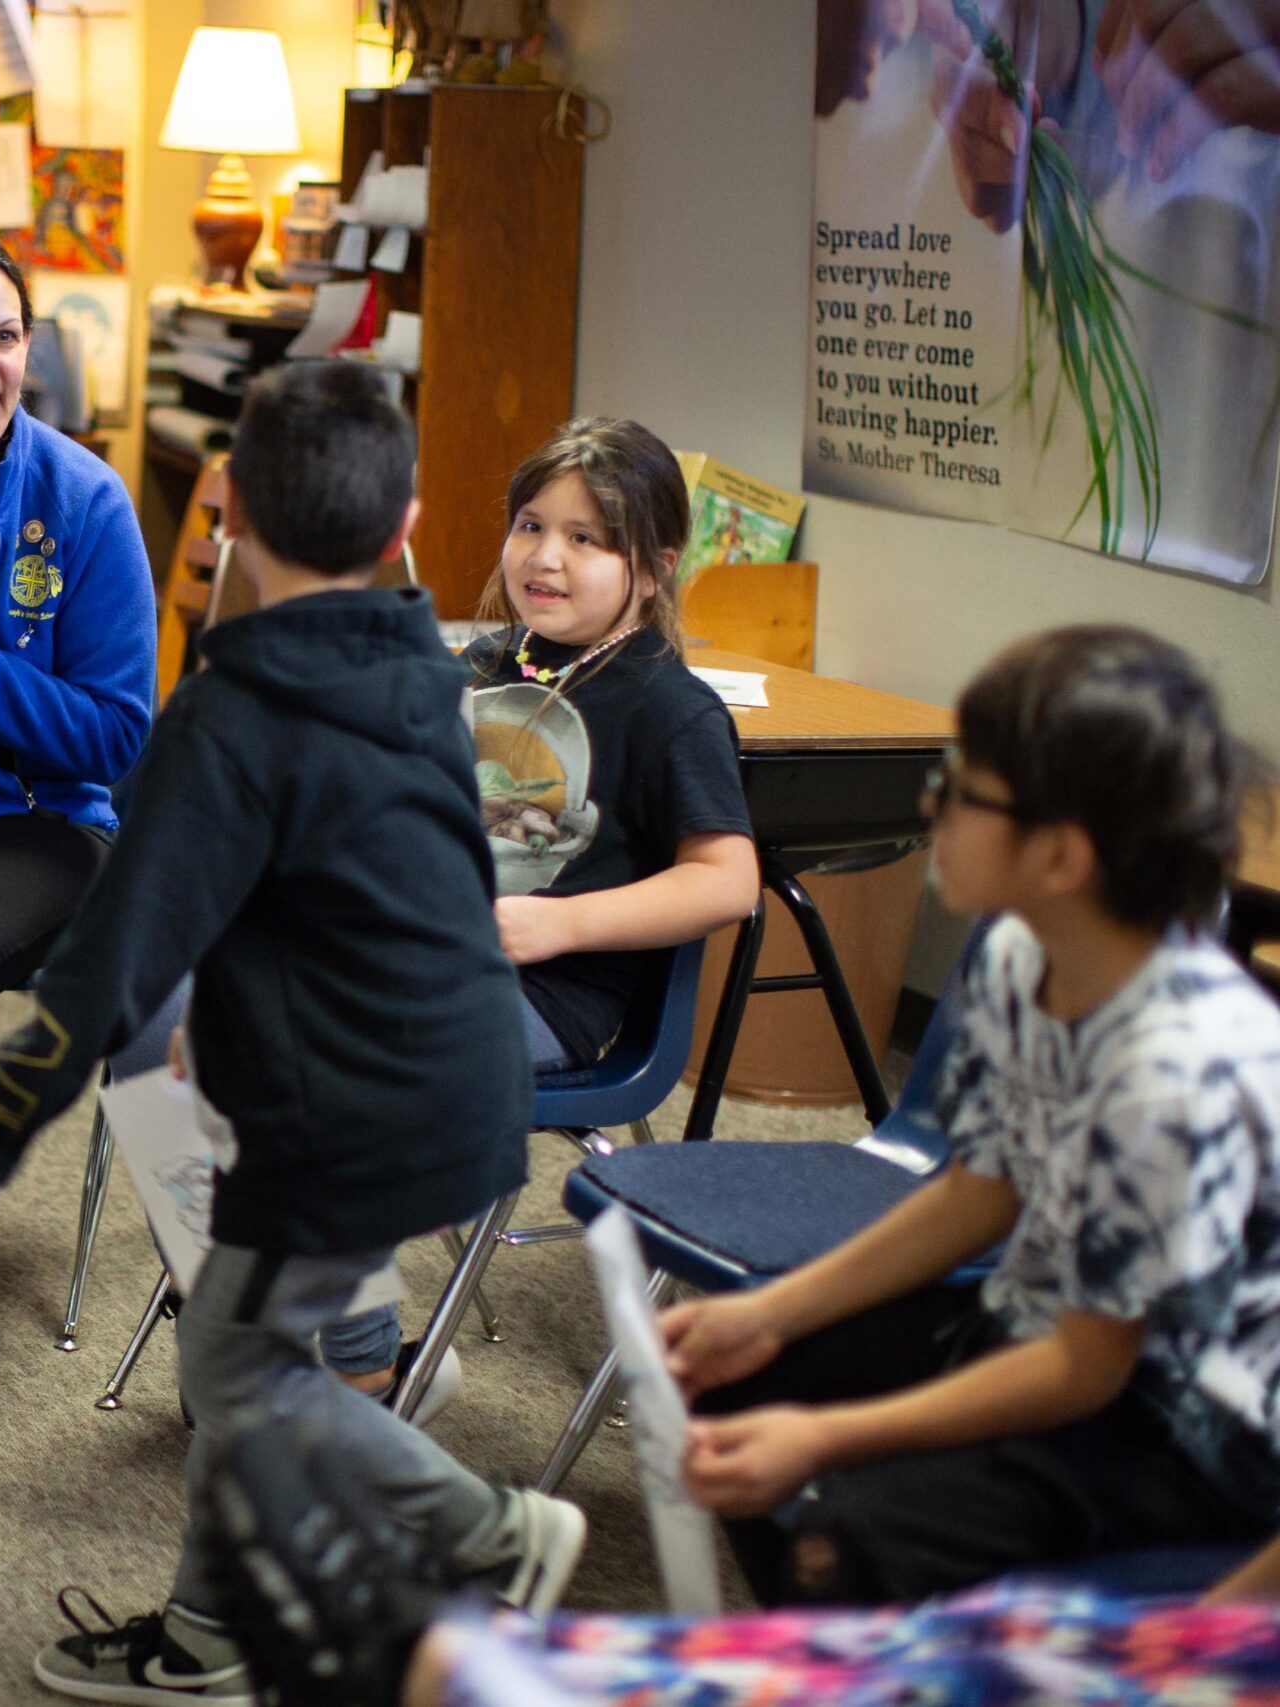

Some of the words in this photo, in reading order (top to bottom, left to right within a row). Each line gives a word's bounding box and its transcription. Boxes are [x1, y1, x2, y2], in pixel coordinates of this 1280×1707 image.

[816, 221, 900, 255] Spread
[908, 224, 951, 252] love
[816, 261, 950, 292] everywhere
[816, 299, 857, 324] you
[865, 304, 897, 329] go.
[904, 299, 937, 326] Let
[944, 309, 973, 330] no
[817, 334, 857, 356] one
[864, 339, 909, 361] ever
[915, 343, 974, 368] come
[817, 368, 838, 390] to
[845, 374, 880, 397] you
[888, 373, 979, 405] without
[817, 400, 897, 439] leaving
[905, 408, 999, 448] happier.
[817, 437, 843, 463] St.
[848, 441, 915, 473] Mother
[920, 452, 1002, 486] Theresa
